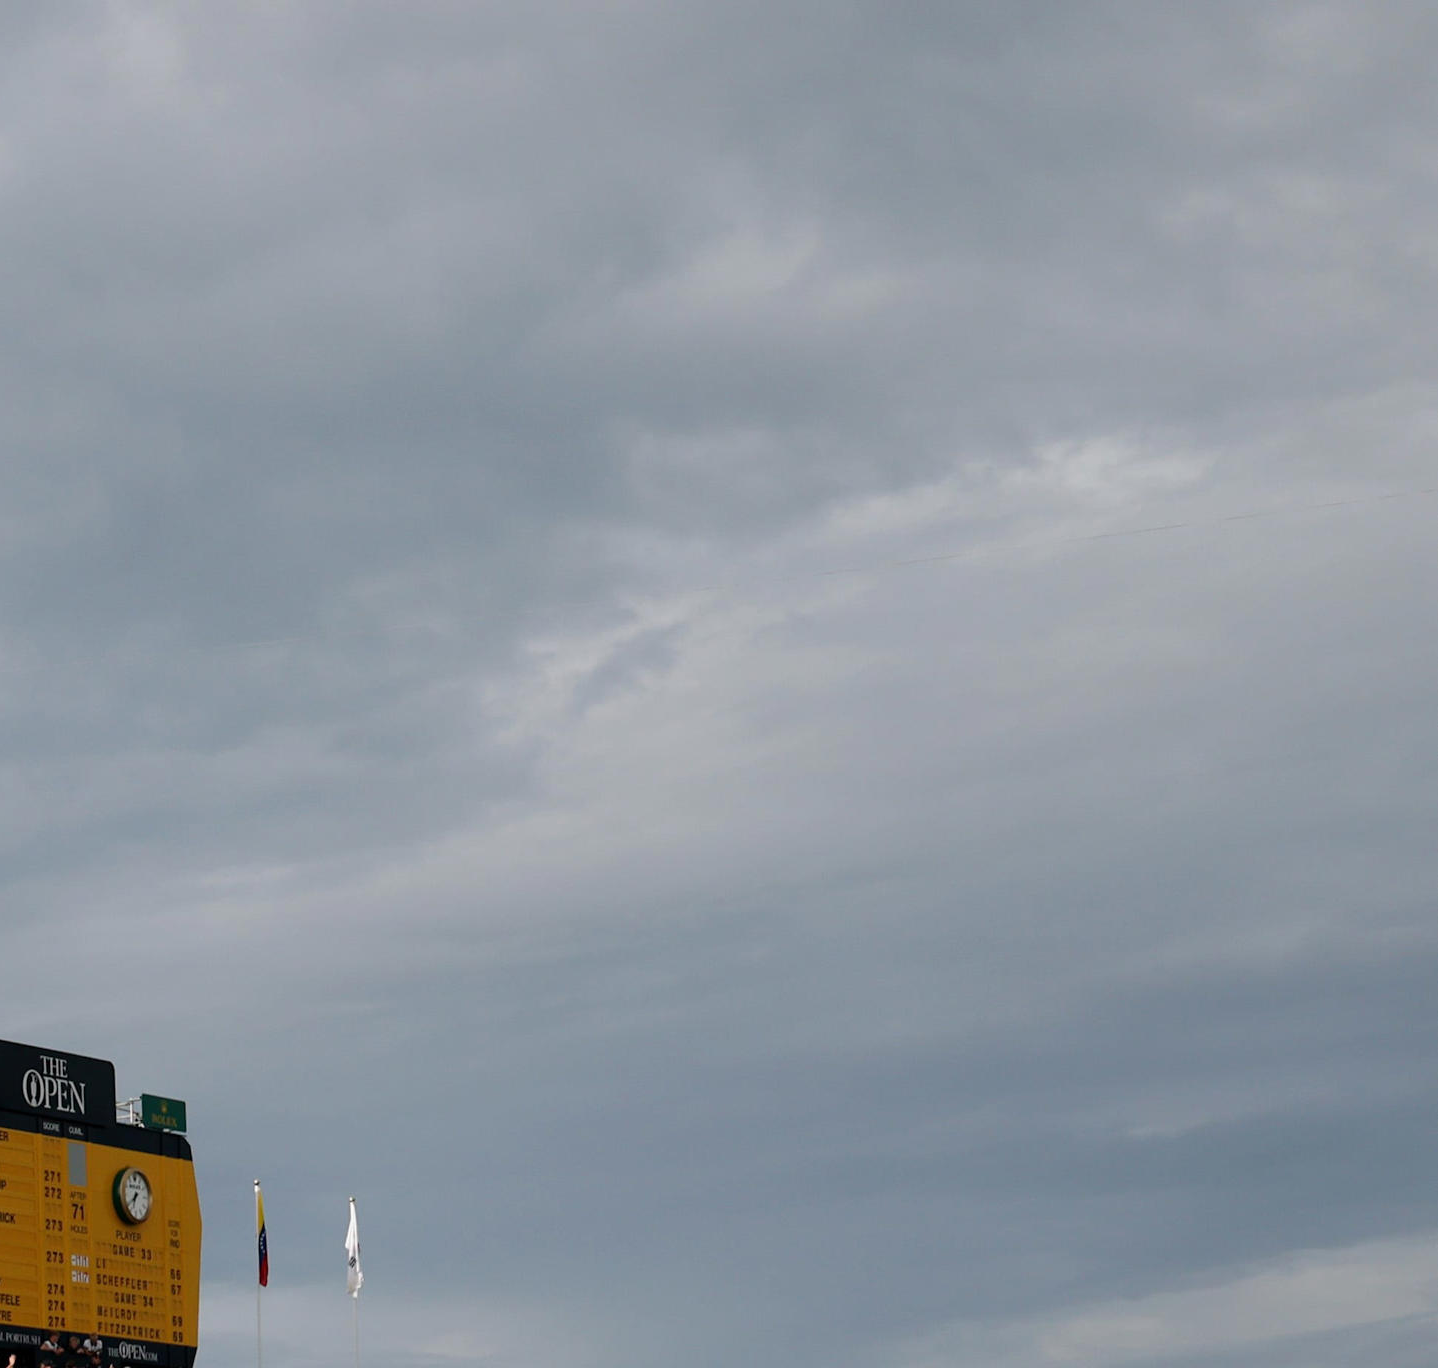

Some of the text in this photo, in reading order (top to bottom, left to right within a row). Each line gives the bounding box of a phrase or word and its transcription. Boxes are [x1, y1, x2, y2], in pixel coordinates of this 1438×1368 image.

[39, 1055, 68, 1078] THE
[22, 1069, 85, 1115] OPEN
[44, 1170, 61, 1183] 271
[44, 1186, 62, 1200] 272
[71, 1203, 85, 1221] 71
[45, 1218, 63, 1232] 273
[115, 1229, 142, 1242] PLAYER
[46, 1251, 64, 1264] 273
[112, 1244, 153, 1261] GAME 33
[46, 1283, 65, 1296] 274
[96, 1273, 148, 1291] SCHEFFLER
[170, 1284, 182, 1296] 67
[47, 1299, 65, 1312] 274
[114, 1291, 154, 1308] GAME 34
[48, 1316, 66, 1328] 274
[172, 1315, 183, 1327] 69
[97, 1321, 184, 1343] FITZPATRICK 69
